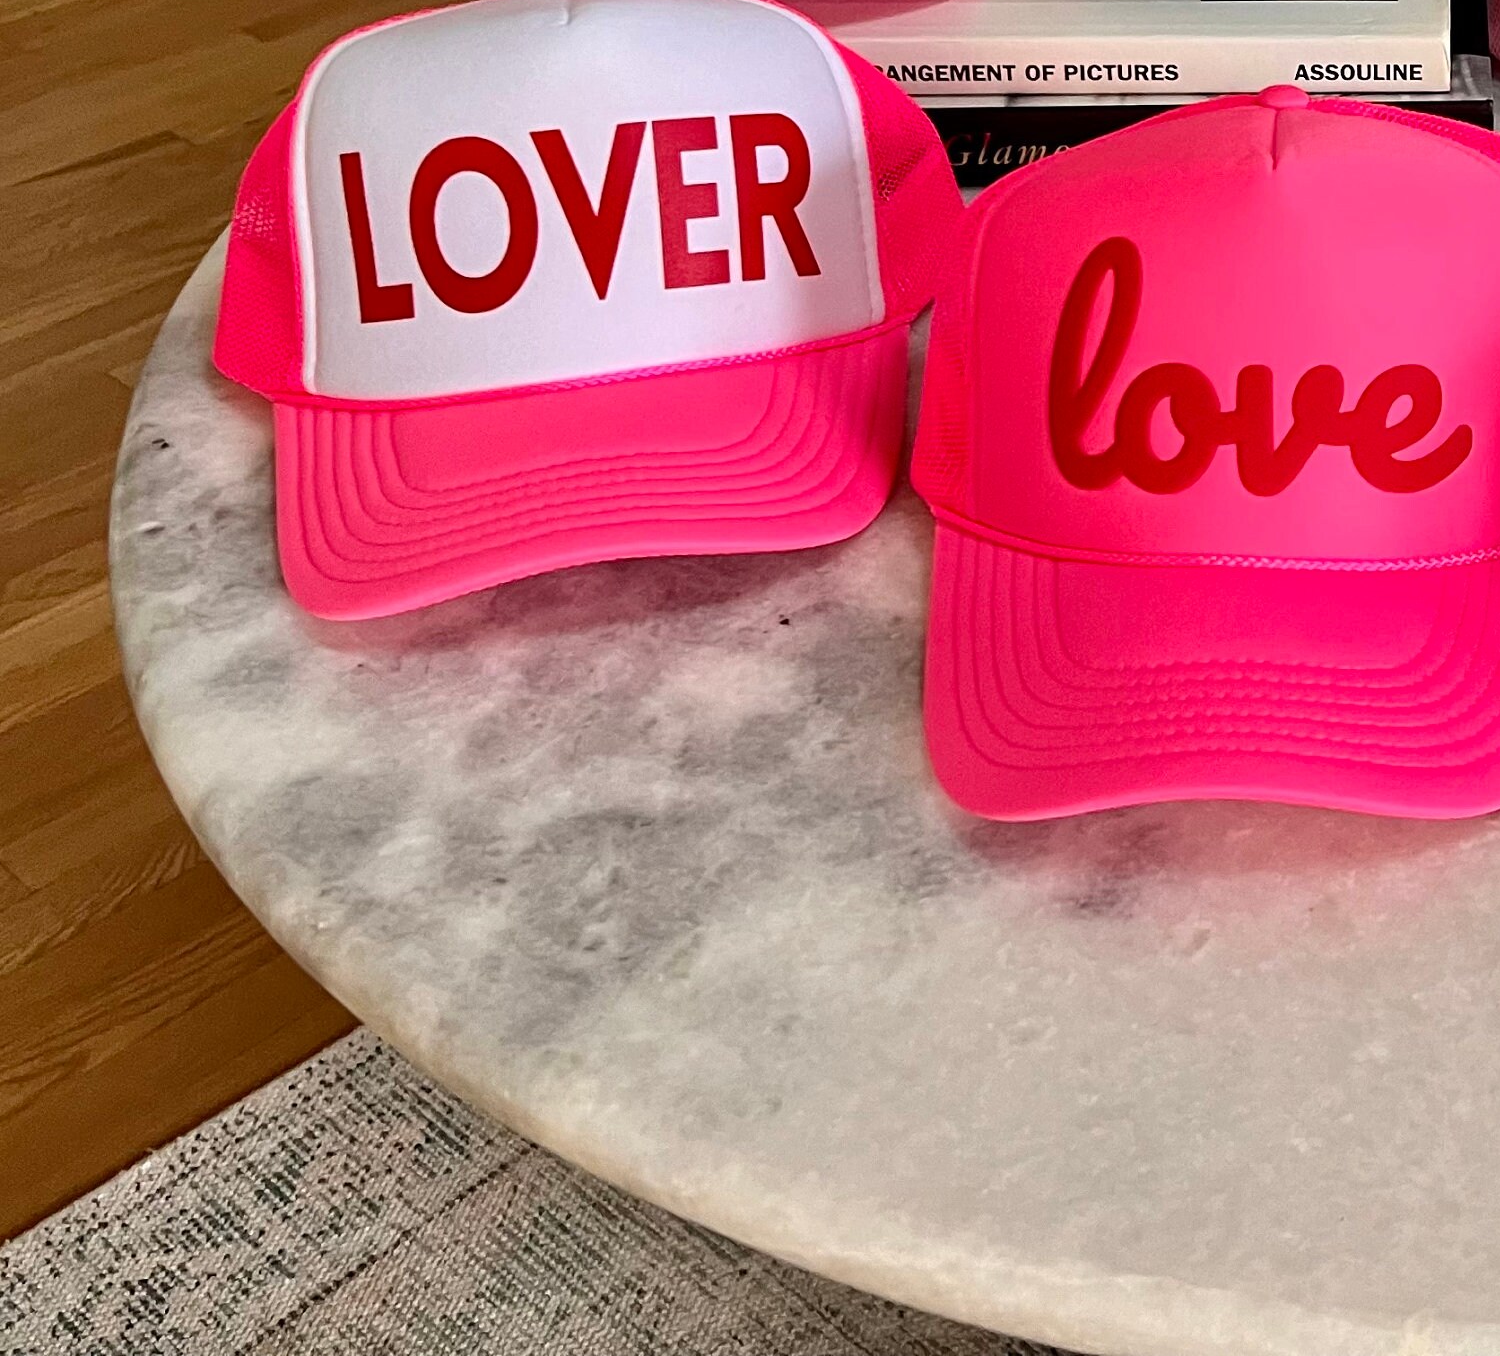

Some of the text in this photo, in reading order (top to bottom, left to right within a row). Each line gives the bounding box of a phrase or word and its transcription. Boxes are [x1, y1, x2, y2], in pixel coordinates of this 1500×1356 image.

[873, 64, 1423, 82] ANGEMENT OF PICTURES ASSOULINE
[339, 112, 822, 324] LOVER
[1048, 235, 1473, 498] love
